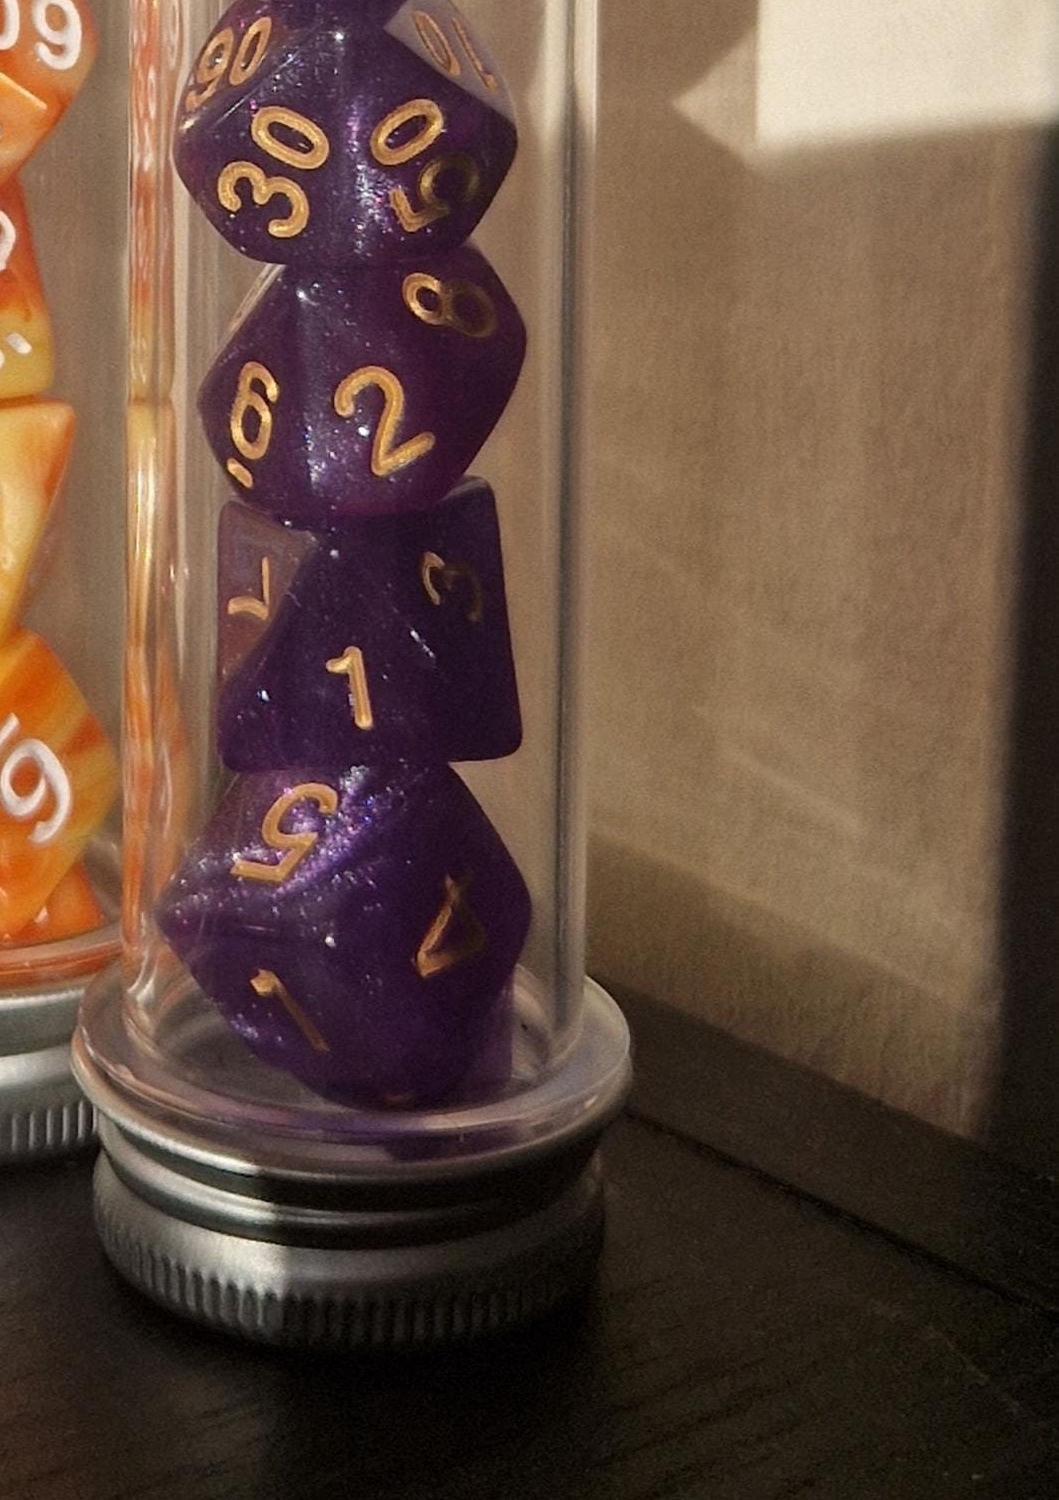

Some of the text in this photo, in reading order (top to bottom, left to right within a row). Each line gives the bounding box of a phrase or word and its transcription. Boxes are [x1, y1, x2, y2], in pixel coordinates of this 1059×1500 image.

[217, 105, 331, 238] 30
[334, 365, 437, 477] 2
[325, 645, 373, 731] 1
[230, 782, 339, 883] 5
